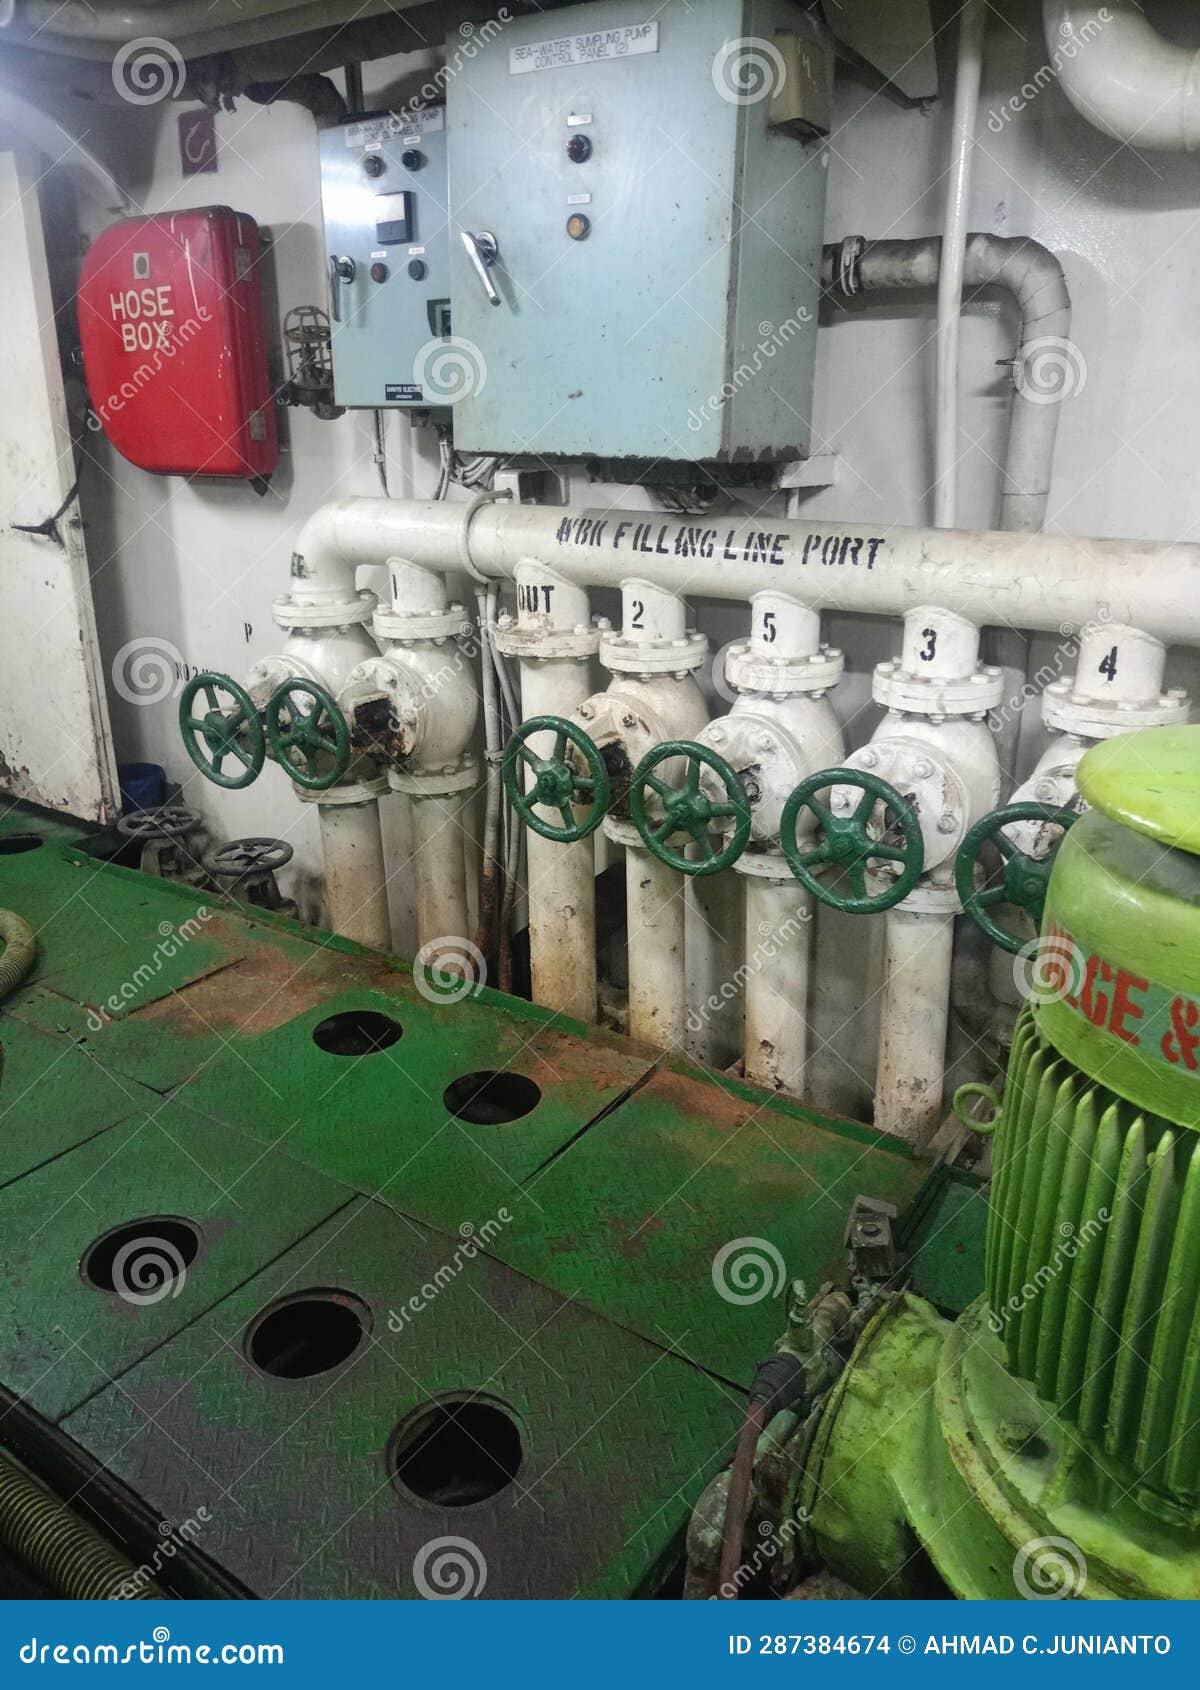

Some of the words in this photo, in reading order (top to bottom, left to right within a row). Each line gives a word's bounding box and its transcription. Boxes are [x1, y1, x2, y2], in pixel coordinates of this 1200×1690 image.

[514, 39, 571, 61] SEA-WATER
[625, 25, 652, 40] PUMP
[534, 52, 575, 68] CONTROL
[580, 45, 610, 60] PANEL
[110, 285, 175, 321] HOSE
[121, 321, 170, 352] BOX
[613, 521, 718, 558] FILLING
[723, 529, 790, 566] LINE
[801, 533, 886, 570] PORT
[517, 584, 555, 614] OUT
[631, 600, 645, 630] 2
[762, 612, 777, 643] 5
[919, 627, 937, 662] 3
[1098, 645, 1118, 682] 4
